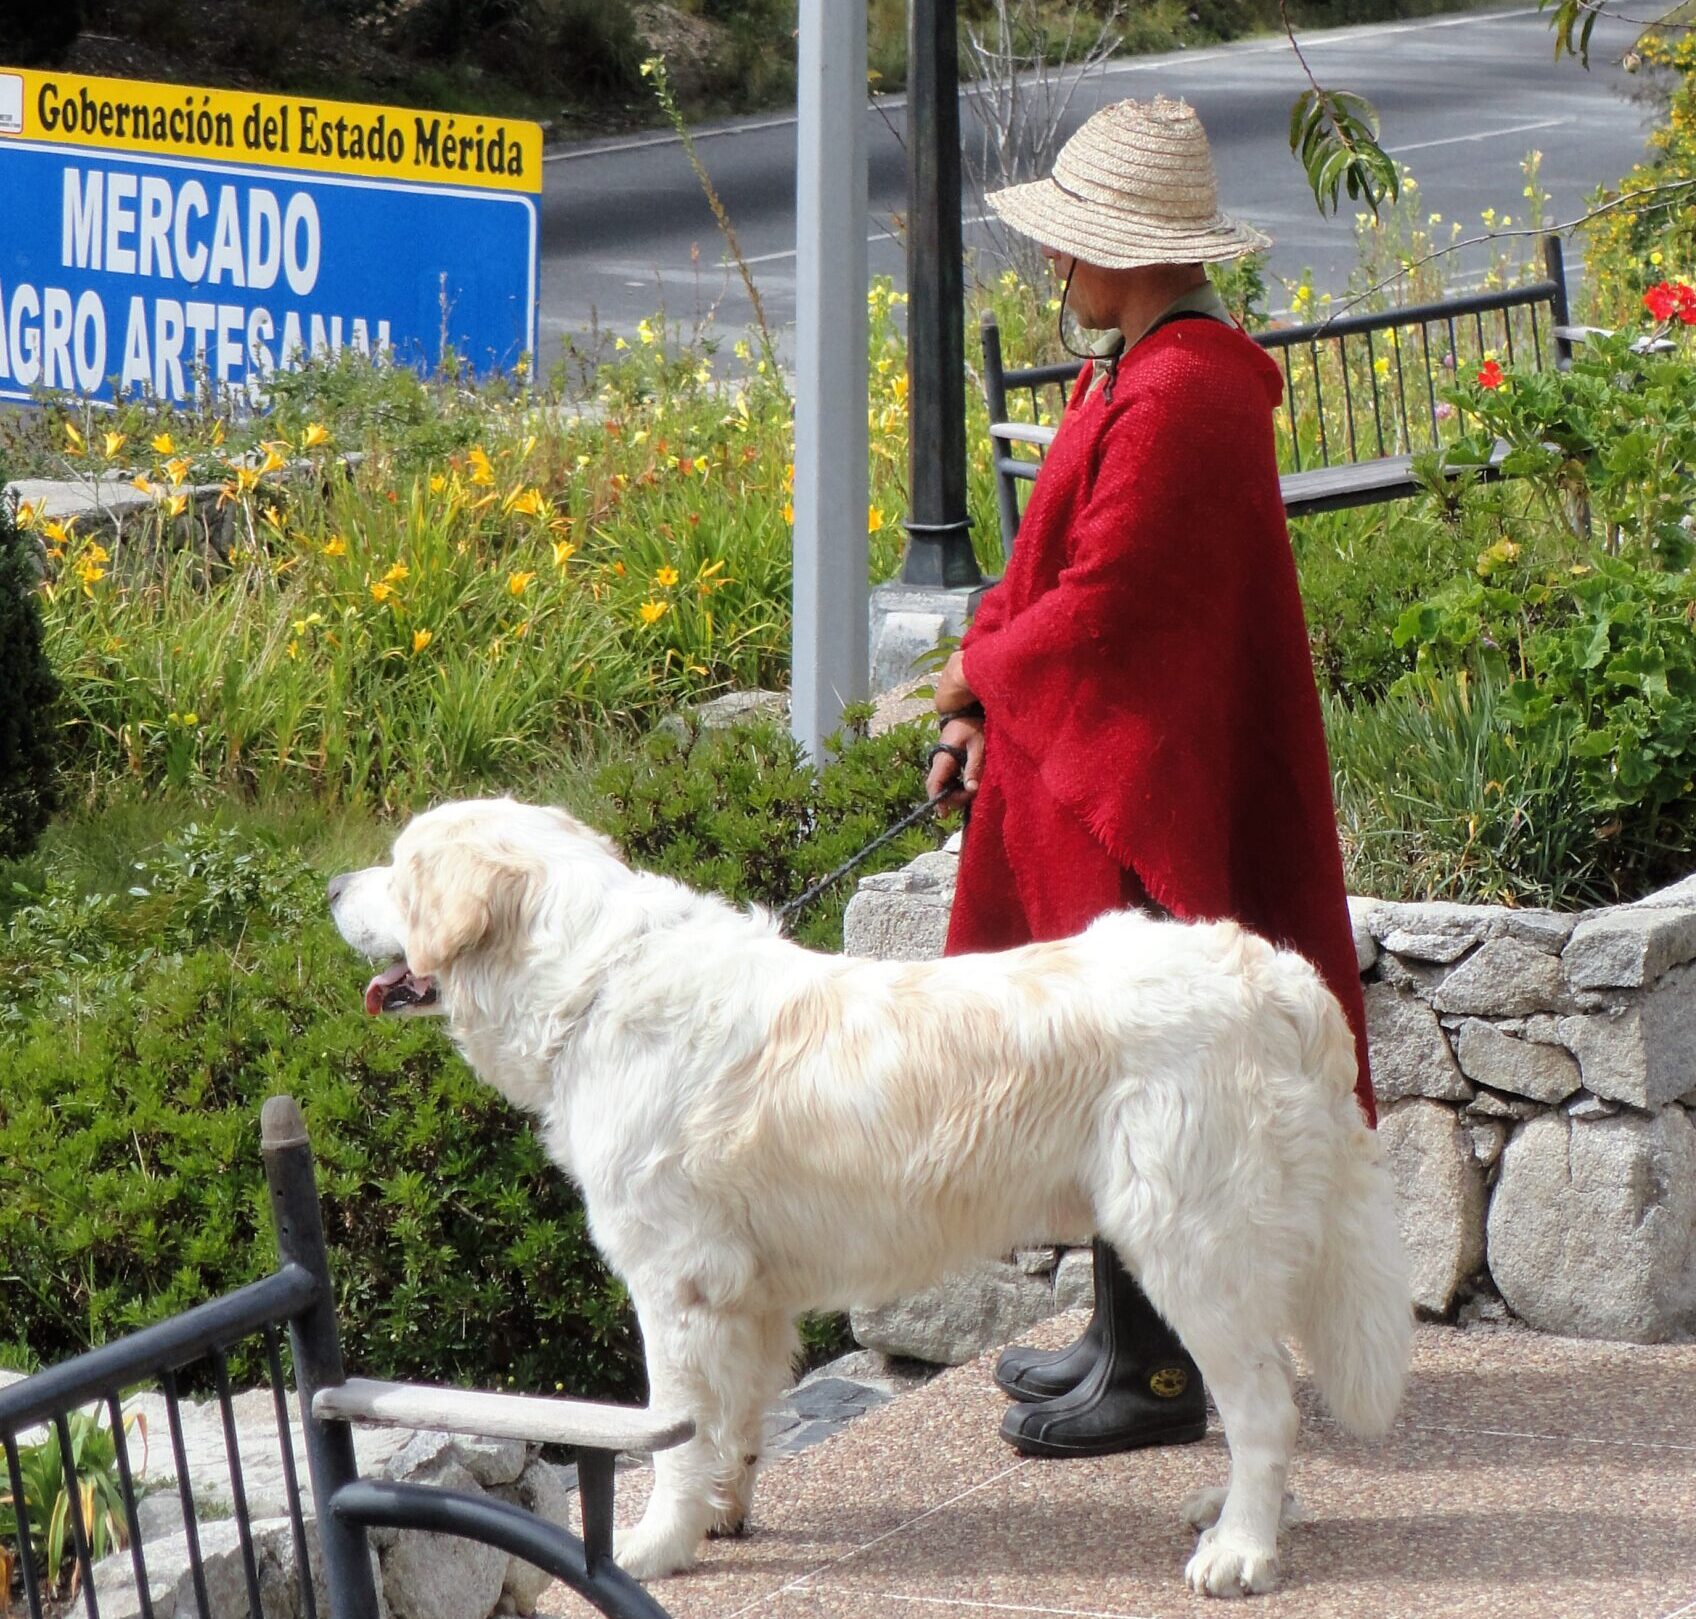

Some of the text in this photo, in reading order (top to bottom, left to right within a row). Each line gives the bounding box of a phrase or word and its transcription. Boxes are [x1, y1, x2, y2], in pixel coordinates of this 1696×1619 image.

[38, 83, 523, 176] Gobernación del Estado Mérida
[62, 168, 320, 296] MERCADO
[0, 283, 107, 393] GRO
